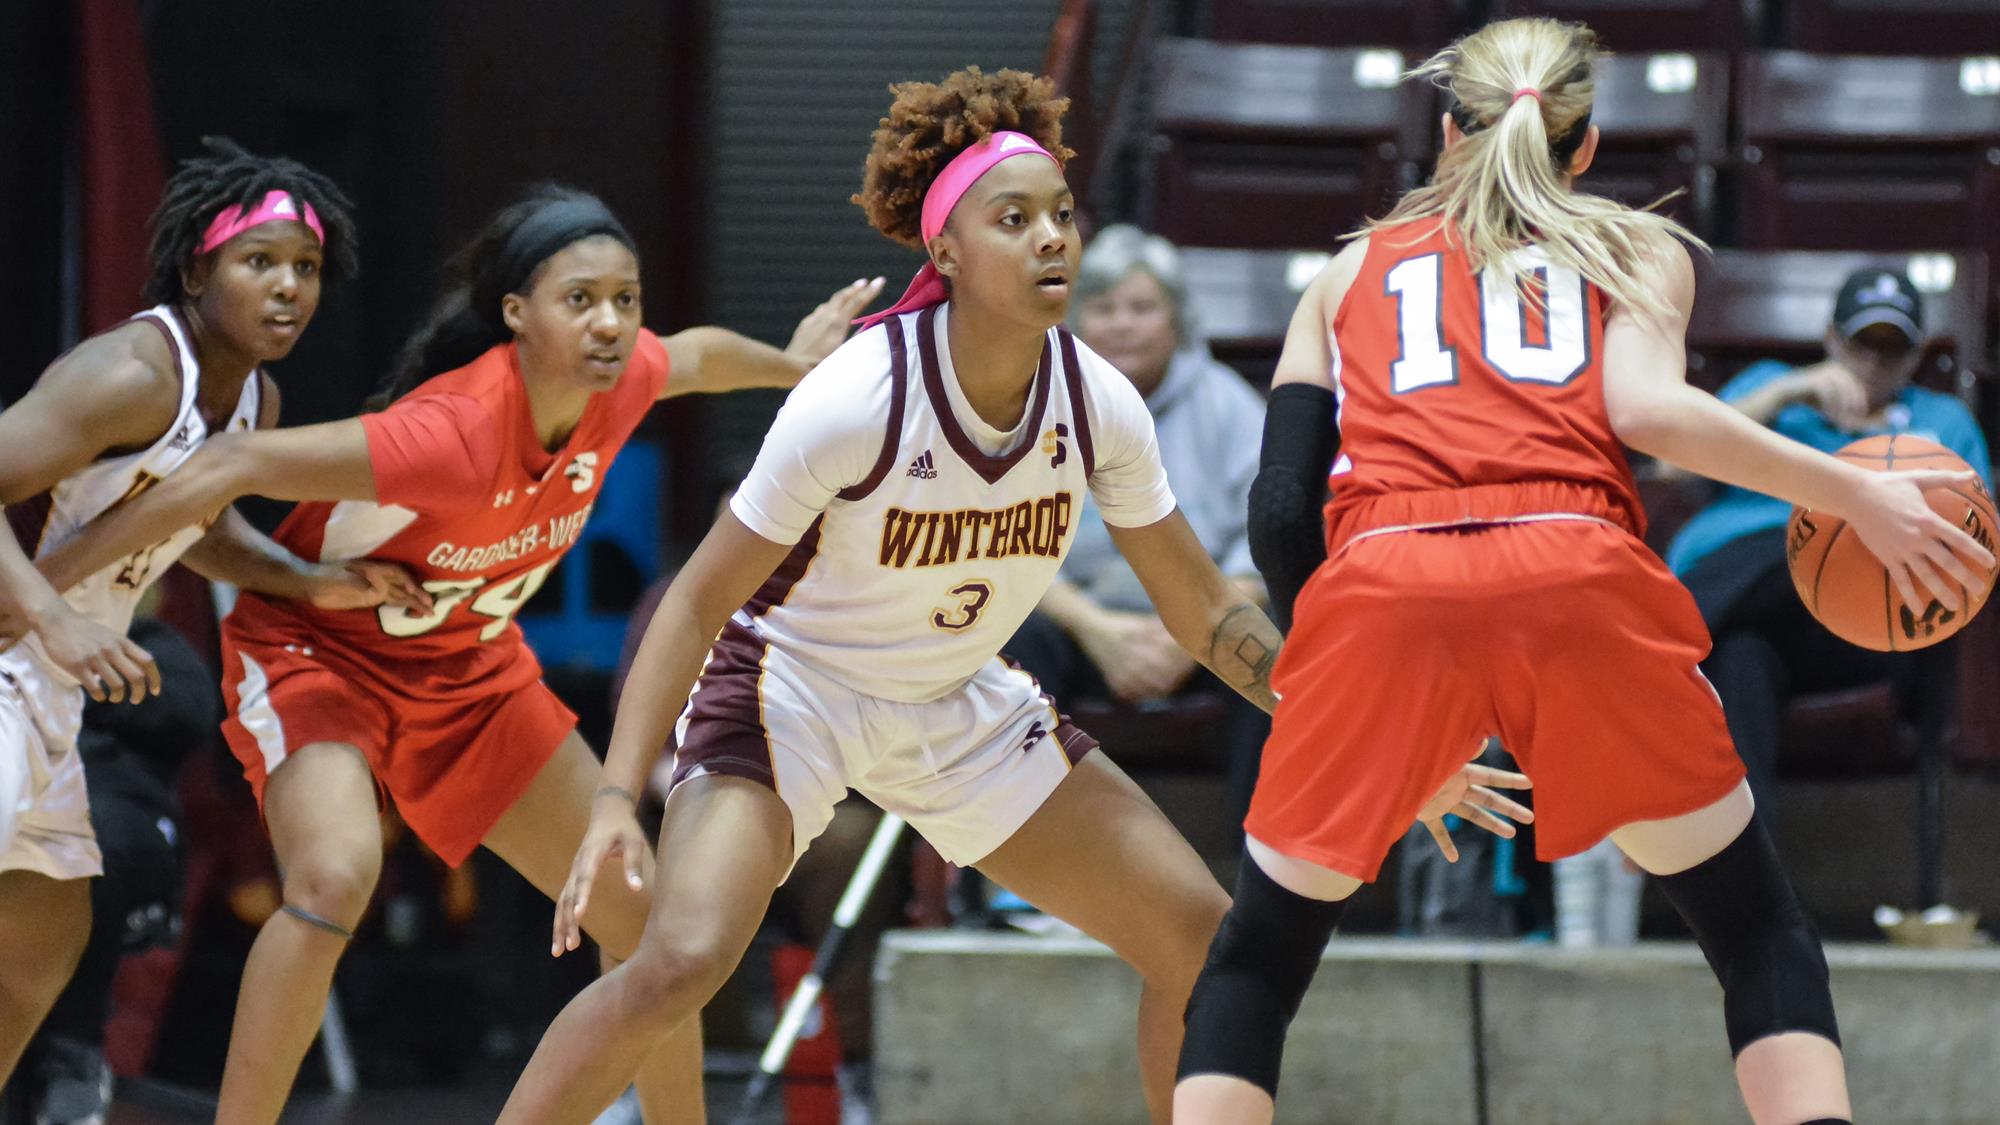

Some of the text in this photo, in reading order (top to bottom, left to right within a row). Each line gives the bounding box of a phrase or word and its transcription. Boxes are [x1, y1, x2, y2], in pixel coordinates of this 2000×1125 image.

[1384, 245, 1592, 395] 10
[905, 467, 938, 480] adidas
[877, 489, 1072, 570] WINTHROP
[928, 578, 996, 636] 3
